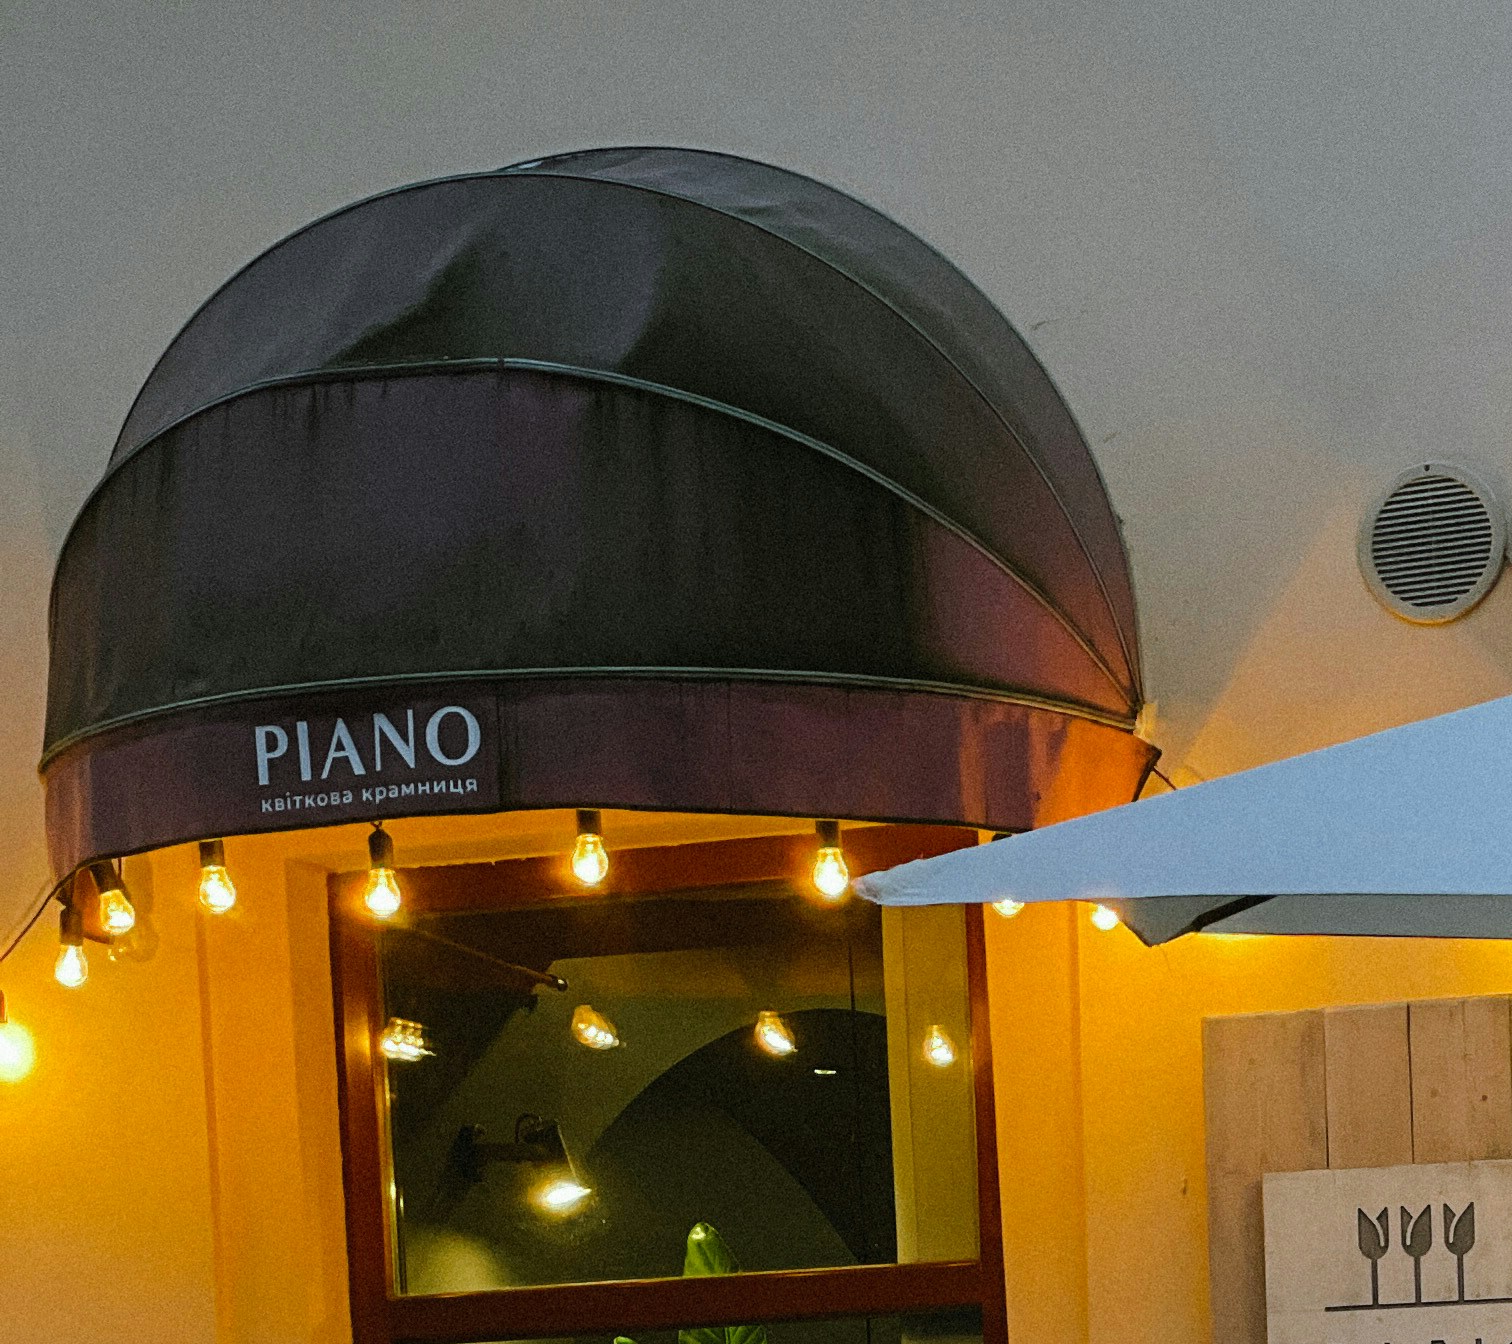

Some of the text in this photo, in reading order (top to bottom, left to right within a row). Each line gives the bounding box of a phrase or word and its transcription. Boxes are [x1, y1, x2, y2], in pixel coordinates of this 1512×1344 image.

[254, 705, 482, 785] PIANO
[261, 778, 478, 813] квіткова крамниця
